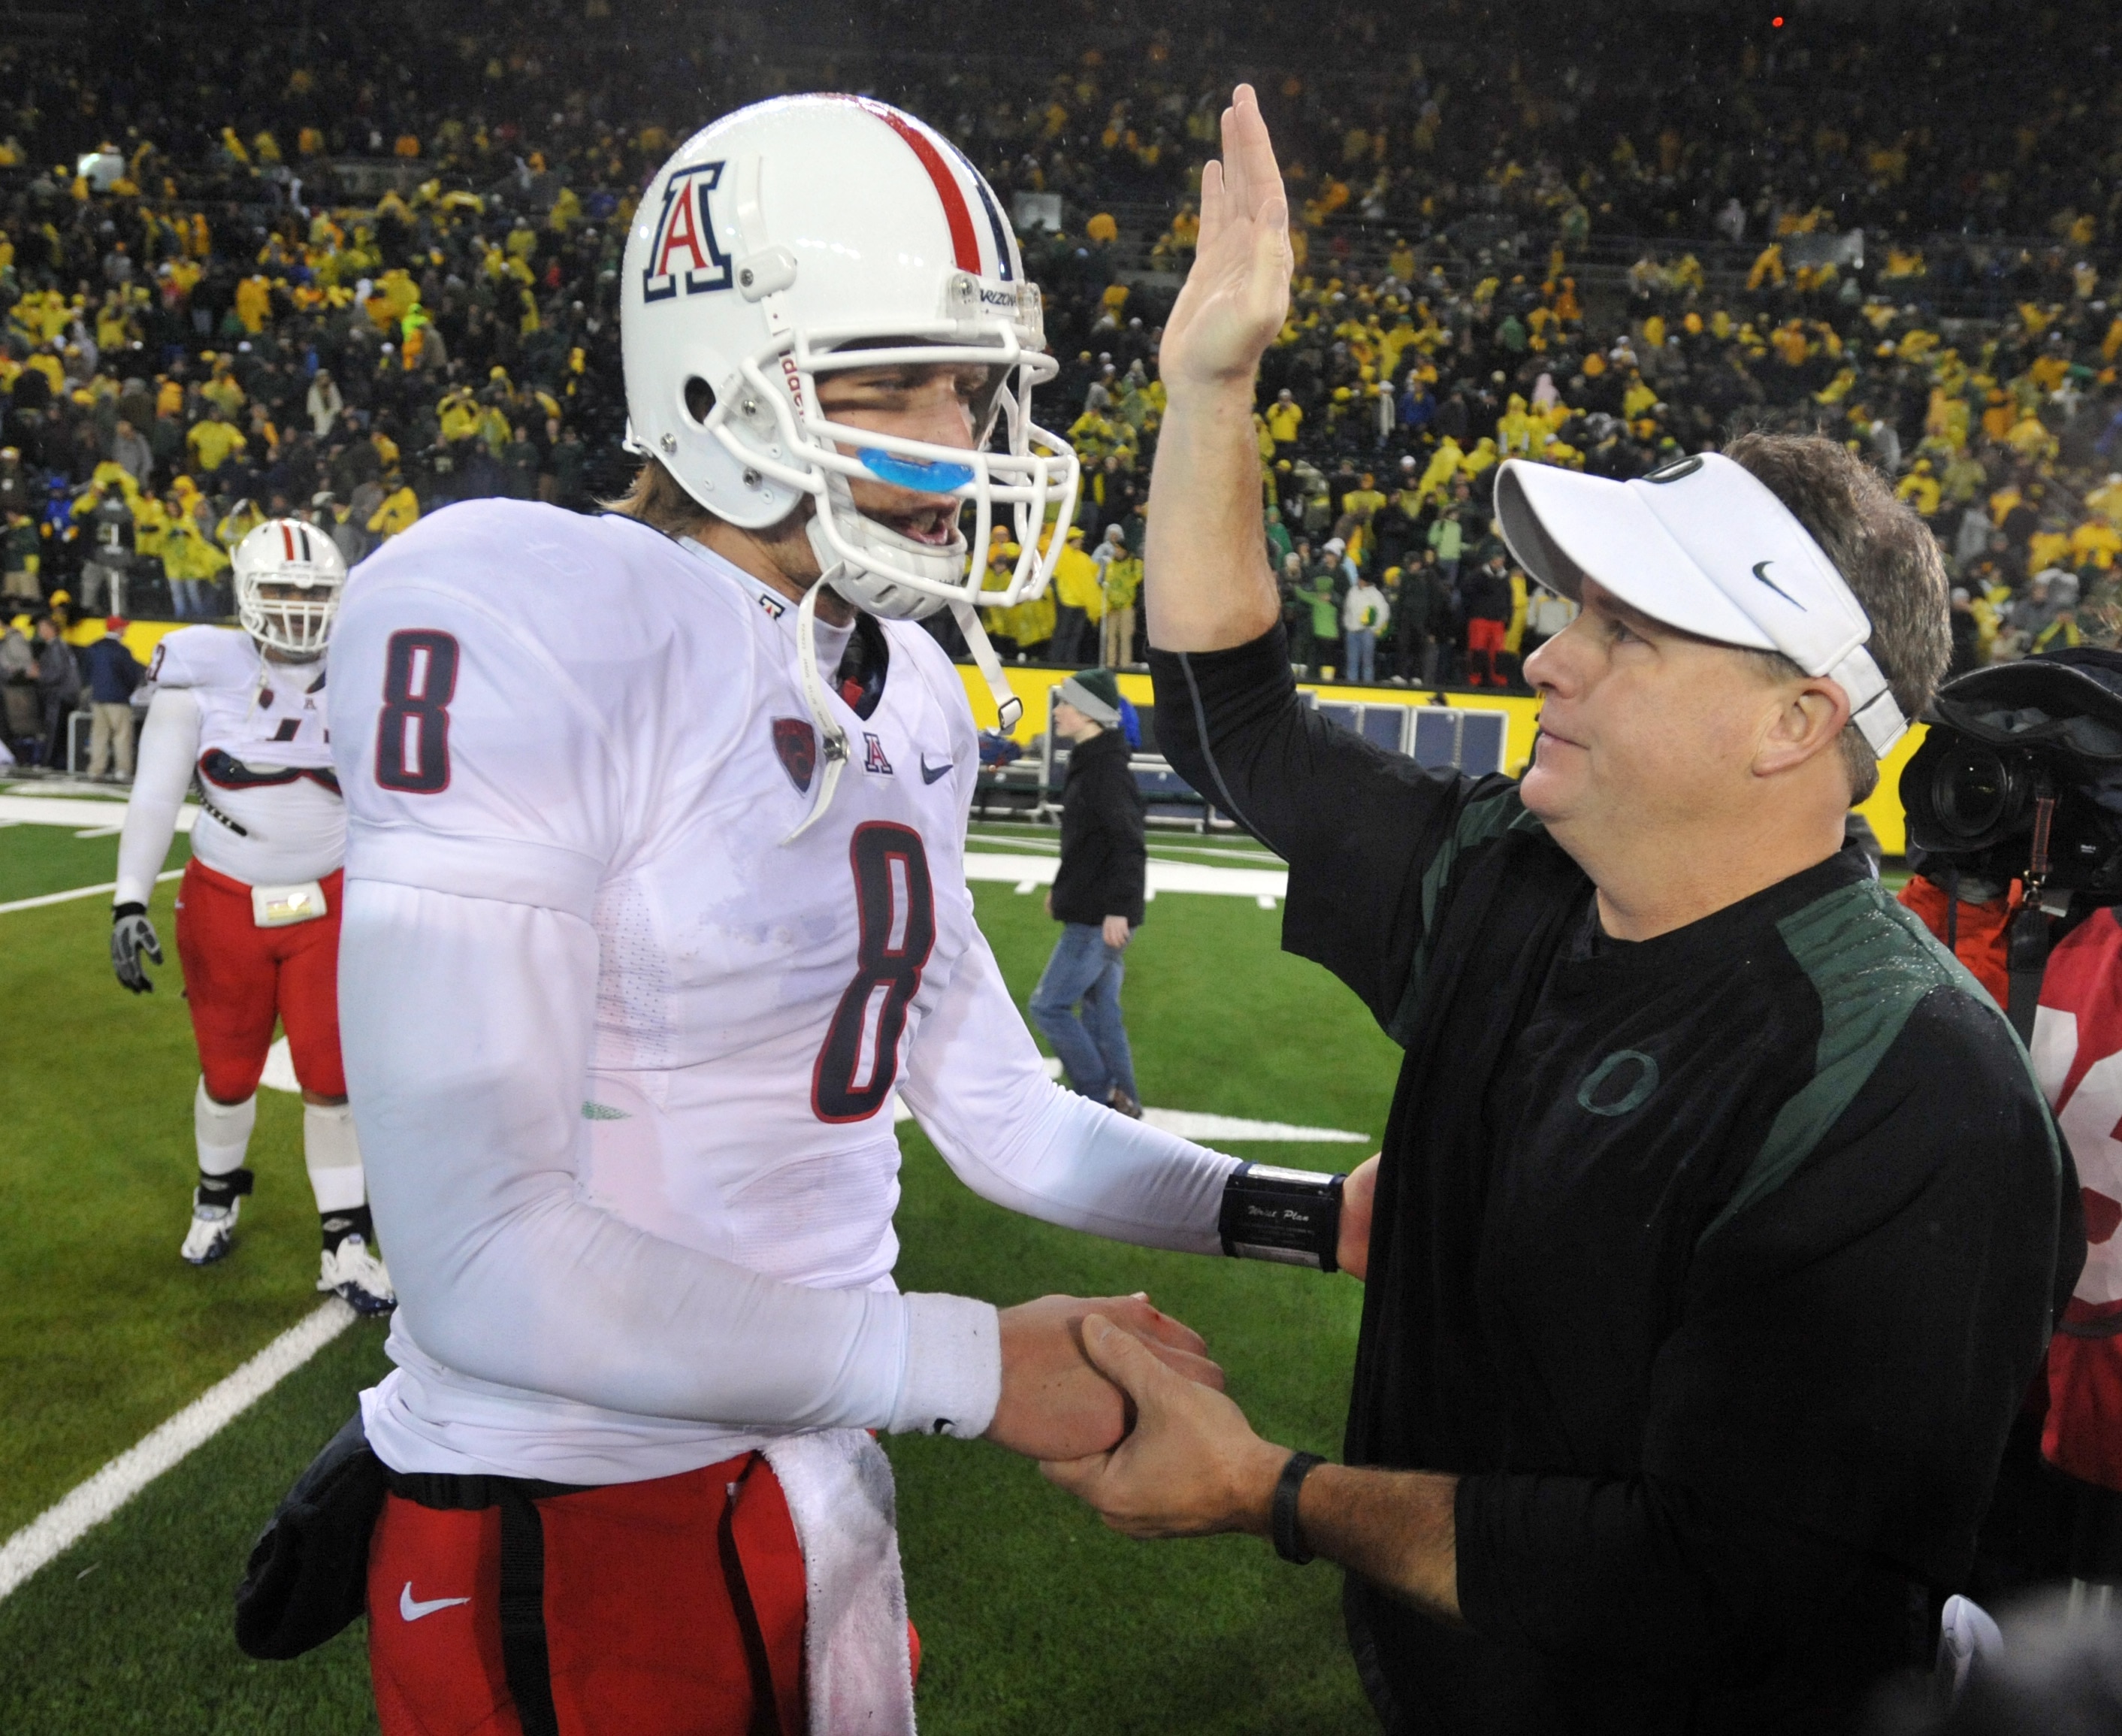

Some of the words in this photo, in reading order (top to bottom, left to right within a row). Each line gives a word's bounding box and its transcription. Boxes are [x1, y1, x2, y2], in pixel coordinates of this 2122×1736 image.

[644, 160, 733, 304] A
[980, 289, 1016, 307] RIZON
[375, 628, 460, 794] 8
[863, 731, 893, 775] A
[811, 820, 936, 1124] 8
[1283, 1209, 1309, 1221] Plan
